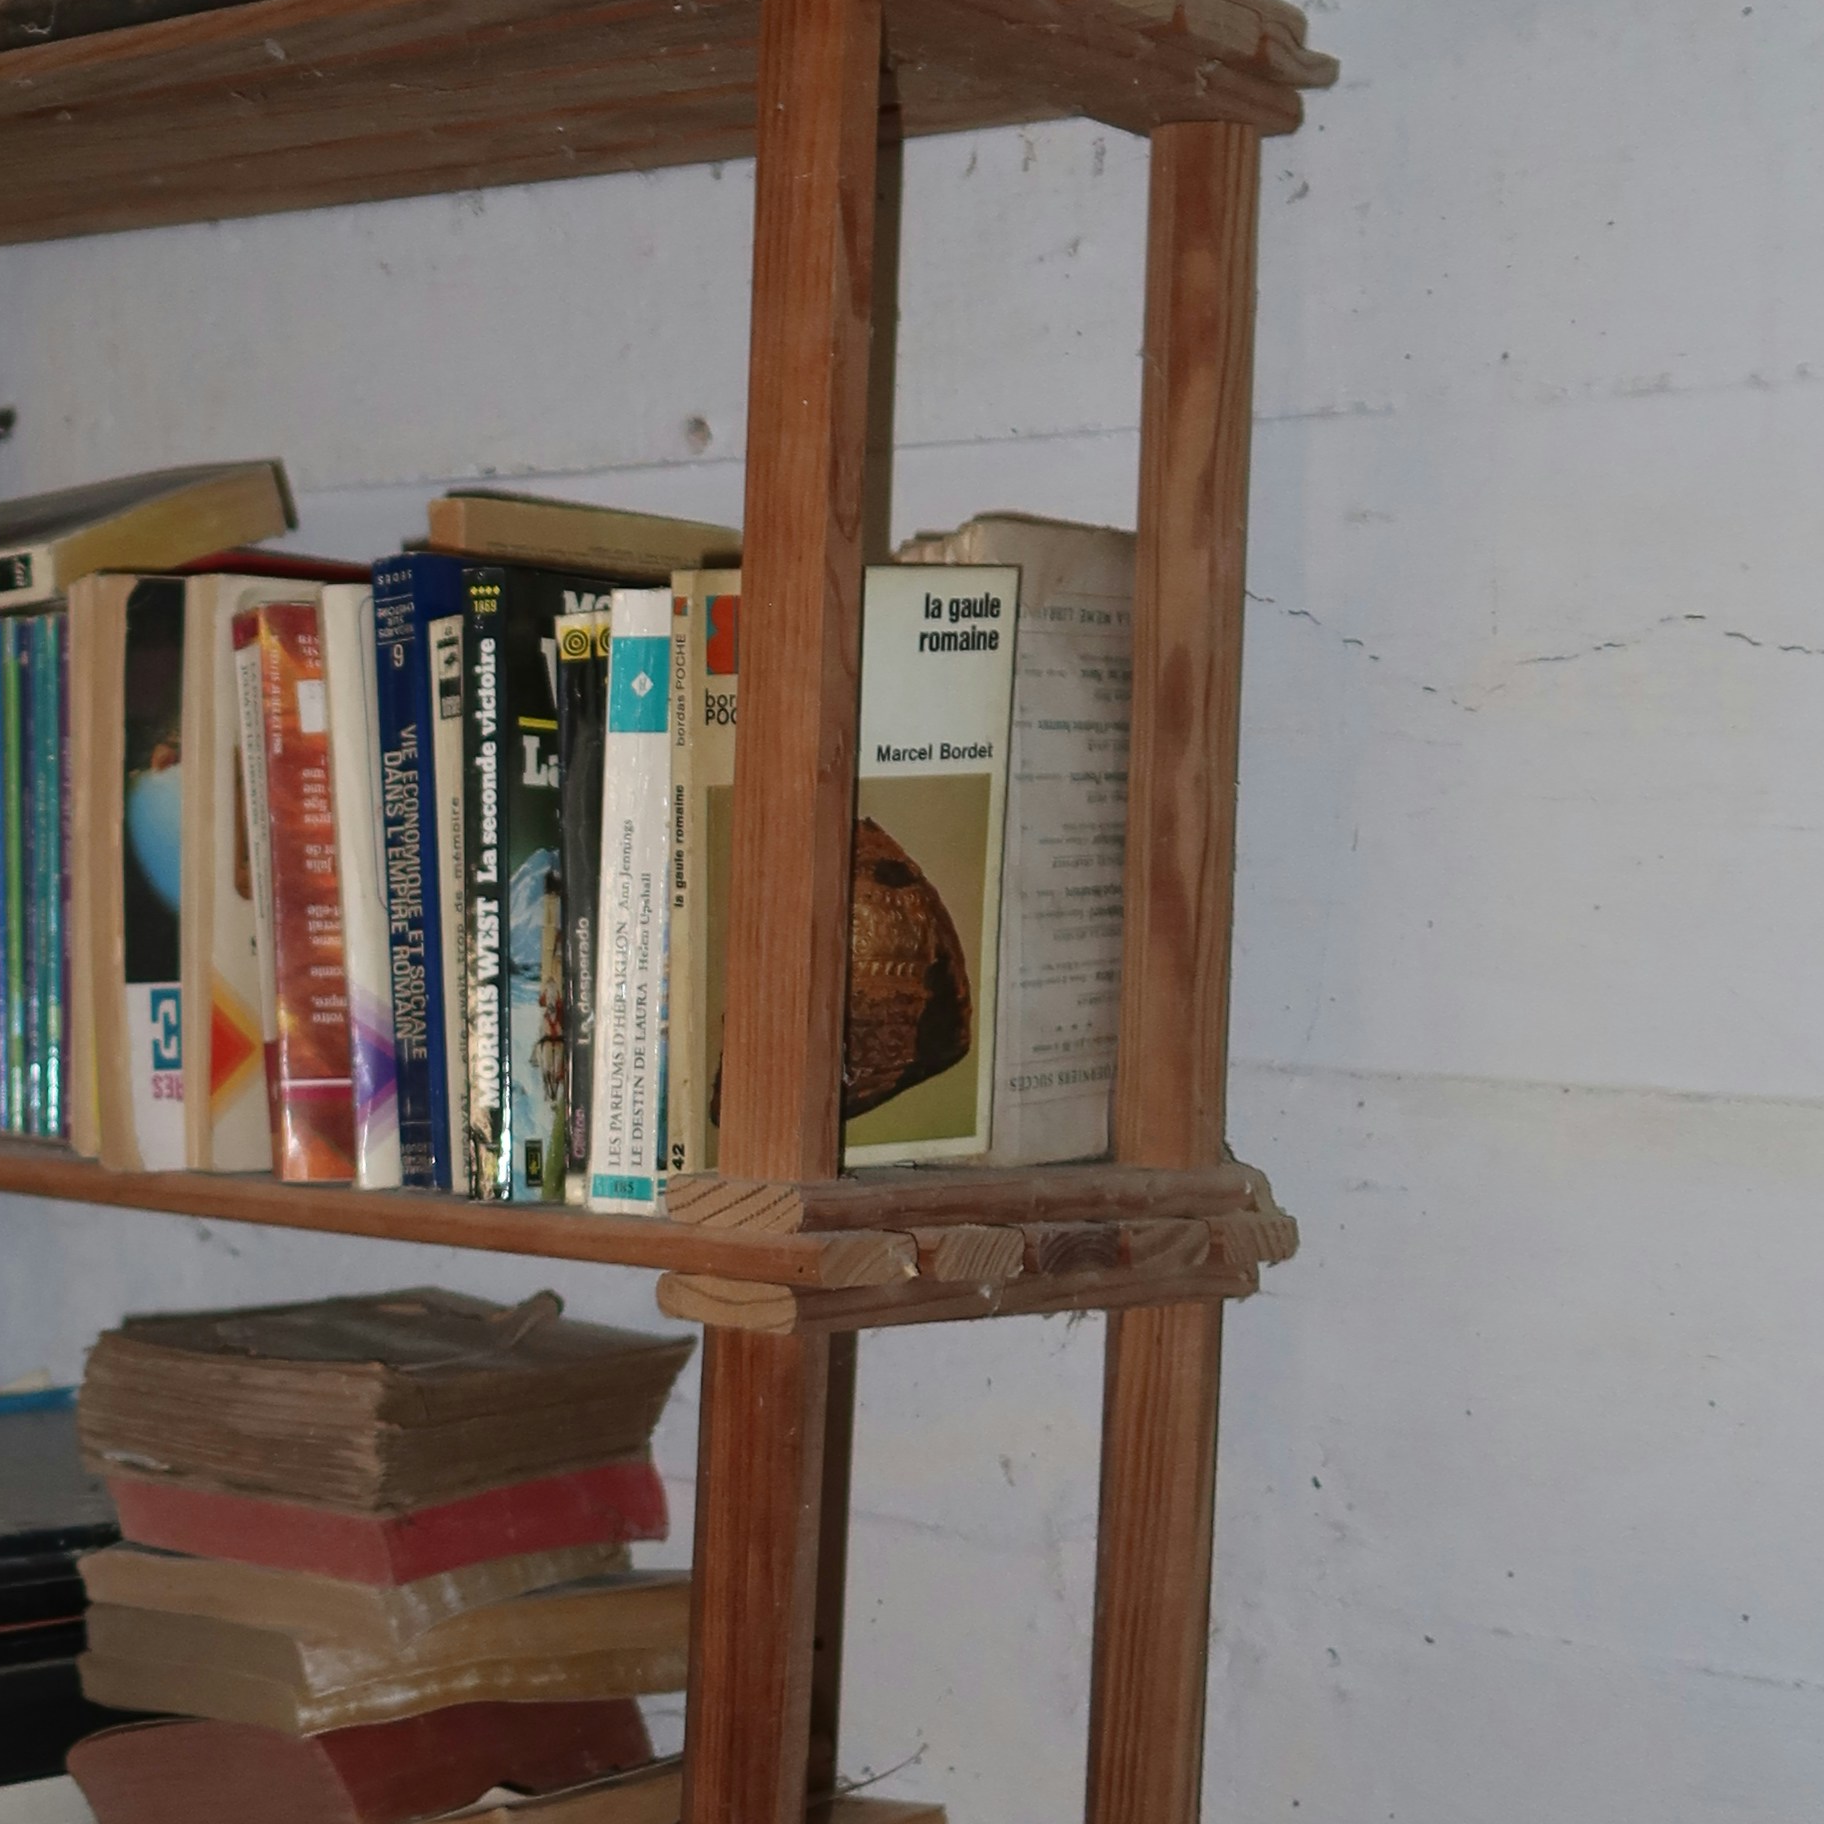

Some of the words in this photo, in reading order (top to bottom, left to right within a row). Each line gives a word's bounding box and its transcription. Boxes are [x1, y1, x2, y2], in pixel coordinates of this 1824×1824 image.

[924, 592, 942, 620] la
[948, 592, 1002, 624] gaule
[675, 633, 688, 691] POCHE
[918, 626, 1000, 653] romaine
[472, 637, 497, 737] victoire
[399, 724, 418, 760] VIE
[675, 693, 687, 747] bordas
[875, 741, 933, 764] Marcel
[939, 739, 994, 761] Bordet
[383, 750, 404, 818] DANS
[474, 740, 498, 845] seconde
[451, 796, 464, 880] mémoire
[673, 784, 687, 844] romaine
[402, 769, 424, 919] ECONOMIQUE
[476, 846, 499, 884] La
[618, 818, 635, 880] Jennings
[673, 849, 687, 890] gaule
[384, 825, 410, 934] L'EMPIRE
[454, 891, 465, 912] de
[617, 881, 632, 911] Ann
[639, 871, 653, 926] Upshall
[673, 895, 685, 908] la
[407, 930, 425, 957] ET
[476, 896, 500, 984] WEST
[574, 916, 592, 1014] desperado
[392, 946, 414, 1039] ROMAIN
[409, 964, 428, 1060] SOCIALE
[634, 982, 649, 1040] LAURA
[476, 983, 501, 1110] MORRIS
[633, 1045, 646, 1071] DE
[609, 1050, 626, 1140] PARFUMS
[631, 1076, 645, 1142] DESTIN
[607, 1140, 622, 1168] LES
[630, 1148, 643, 1167] LE
[671, 1142, 687, 1172] 42
